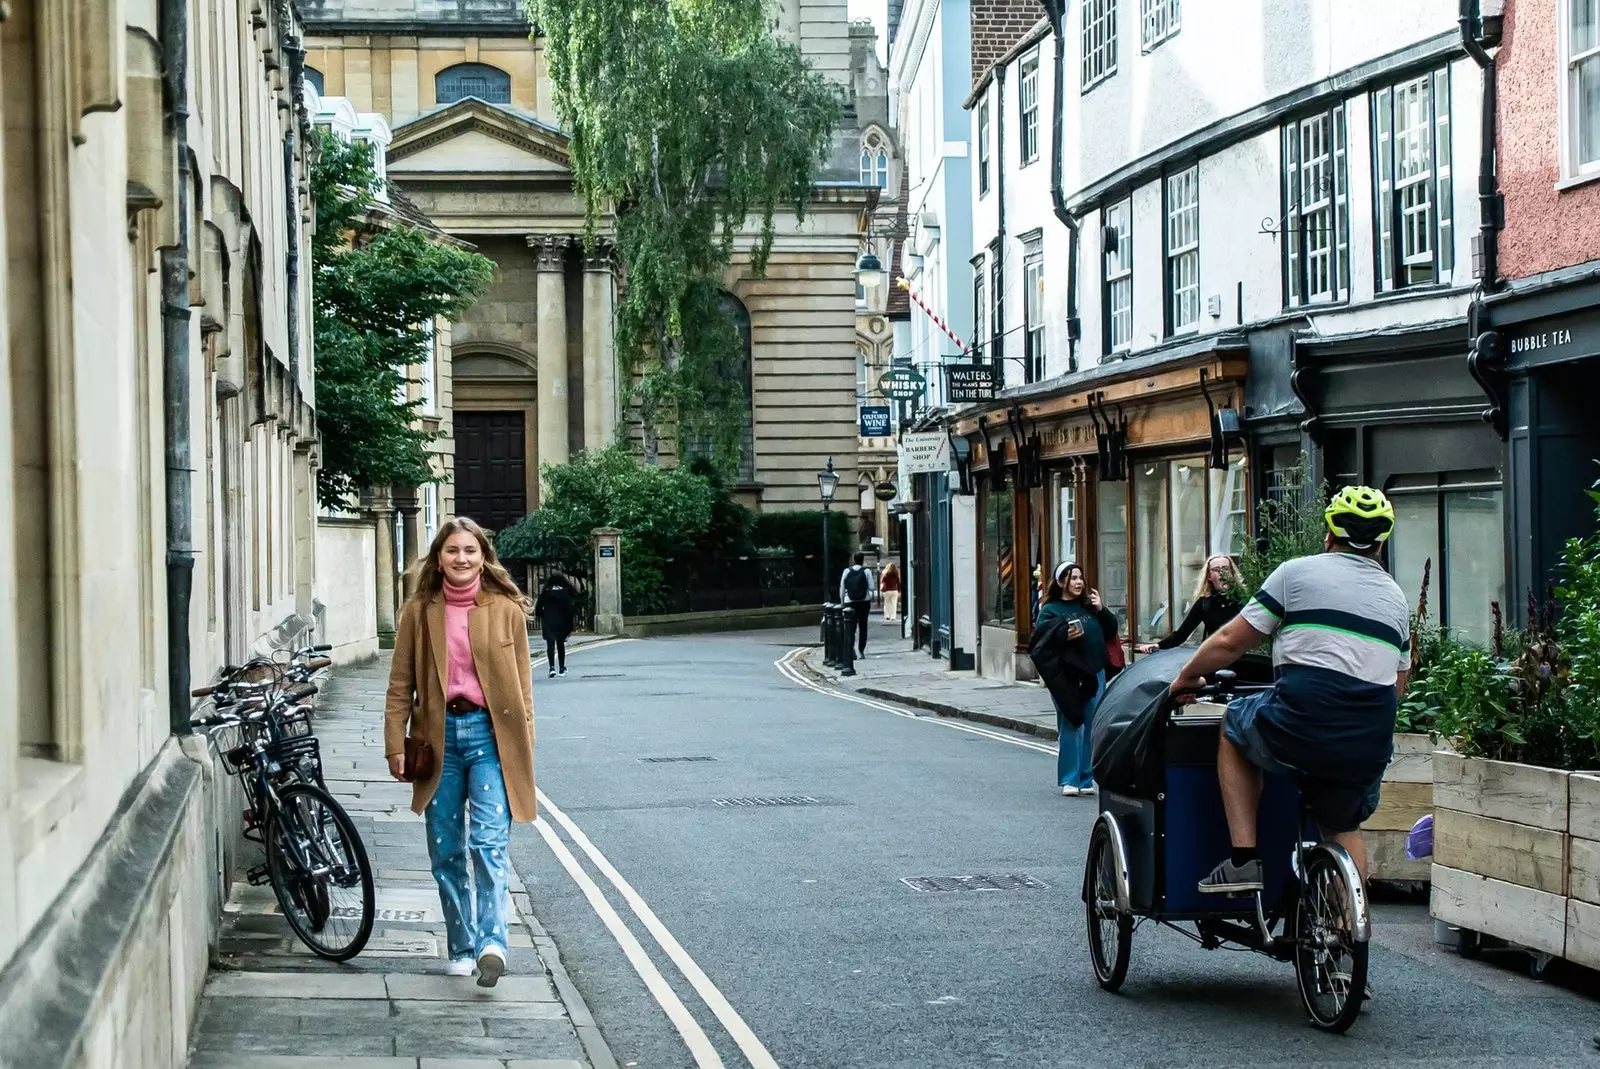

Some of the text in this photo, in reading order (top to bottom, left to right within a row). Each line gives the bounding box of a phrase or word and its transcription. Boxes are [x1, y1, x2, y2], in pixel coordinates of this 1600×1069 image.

[1511, 329, 1571, 353] BUBBLE TEA
[952, 371, 991, 380] WALTERS
[880, 381, 925, 390] WHISKY
[952, 389, 964, 398] TEN
[965, 389, 977, 398] THE
[905, 445, 937, 453] BARBERS
